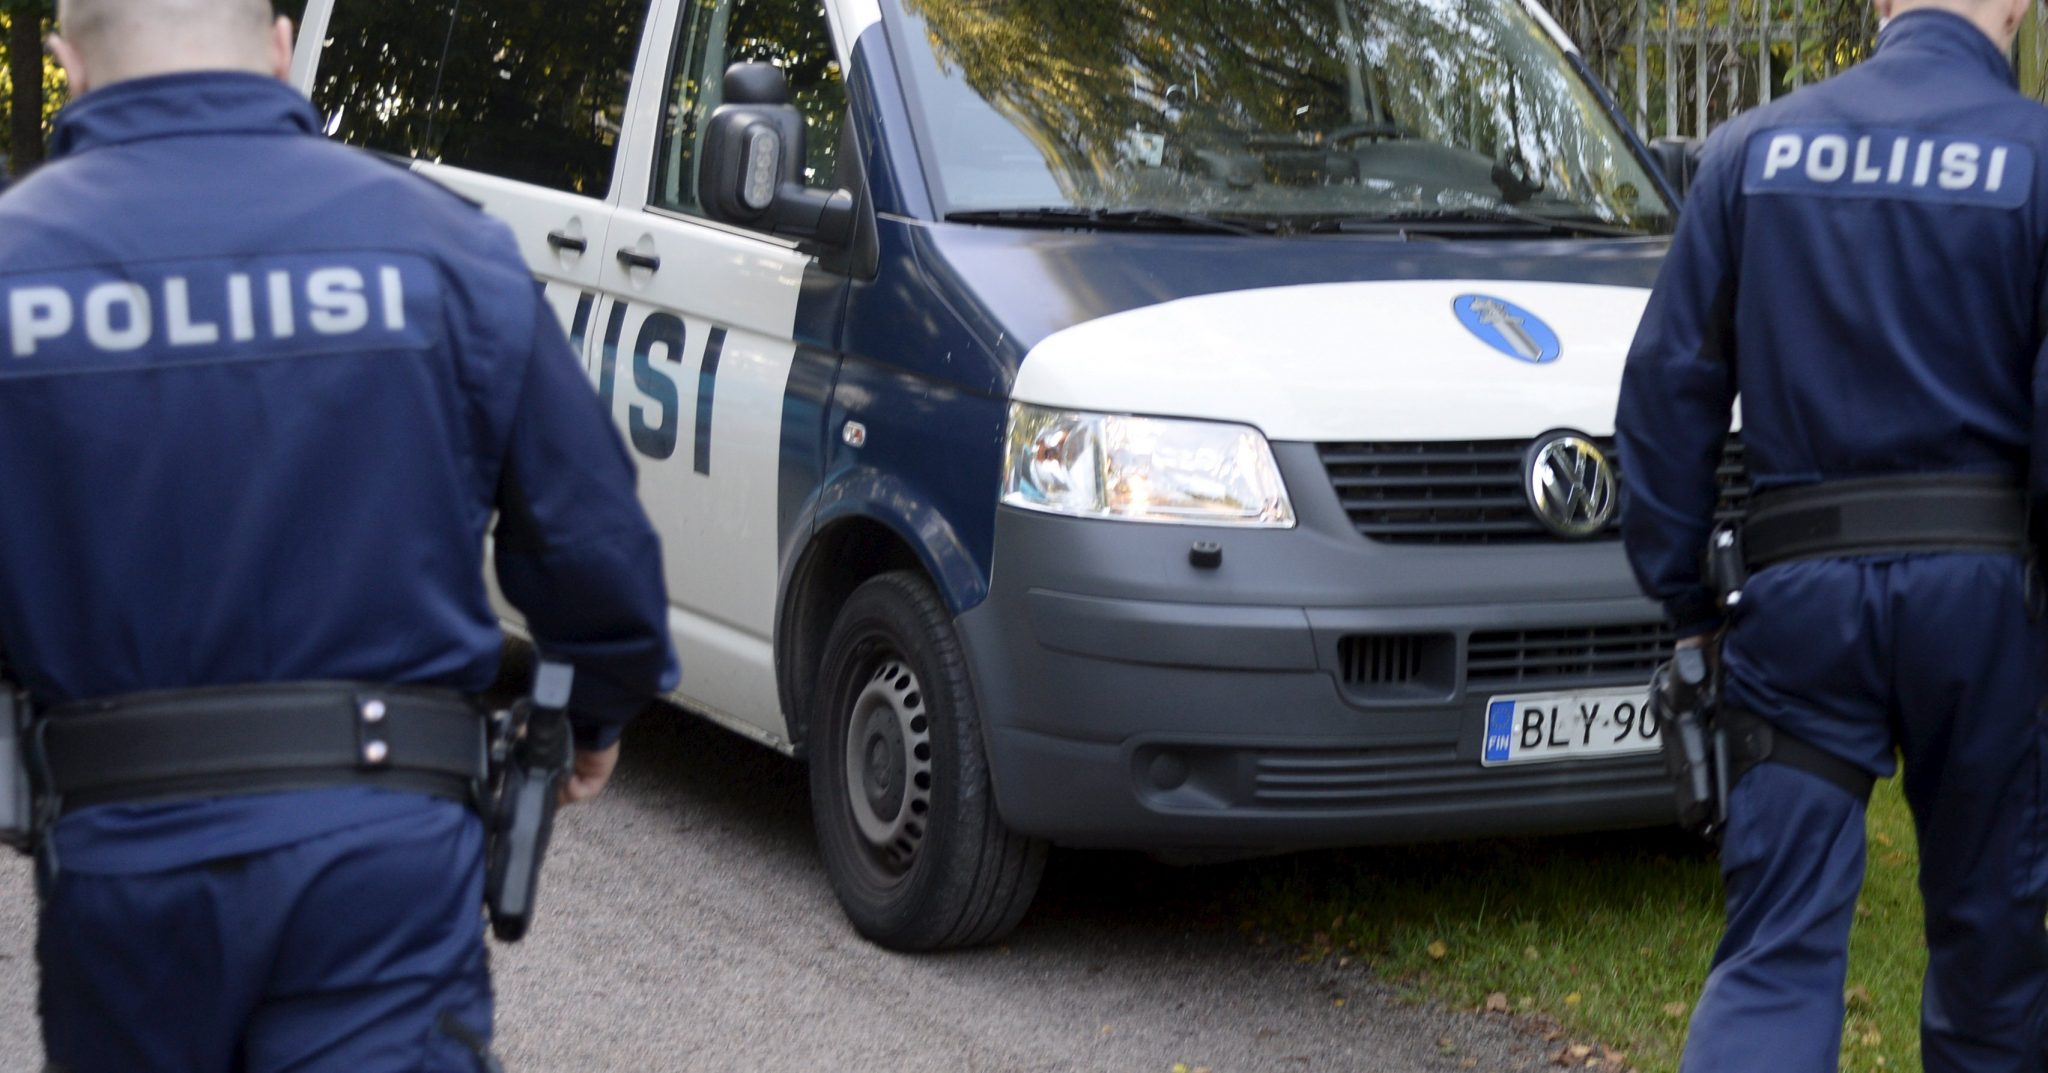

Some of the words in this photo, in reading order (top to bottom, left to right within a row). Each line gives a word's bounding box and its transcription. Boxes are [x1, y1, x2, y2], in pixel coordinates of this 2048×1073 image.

[1763, 133, 2008, 192] POLIISI
[9, 265, 405, 357] POLIISI
[1488, 734, 1510, 751] FIN
